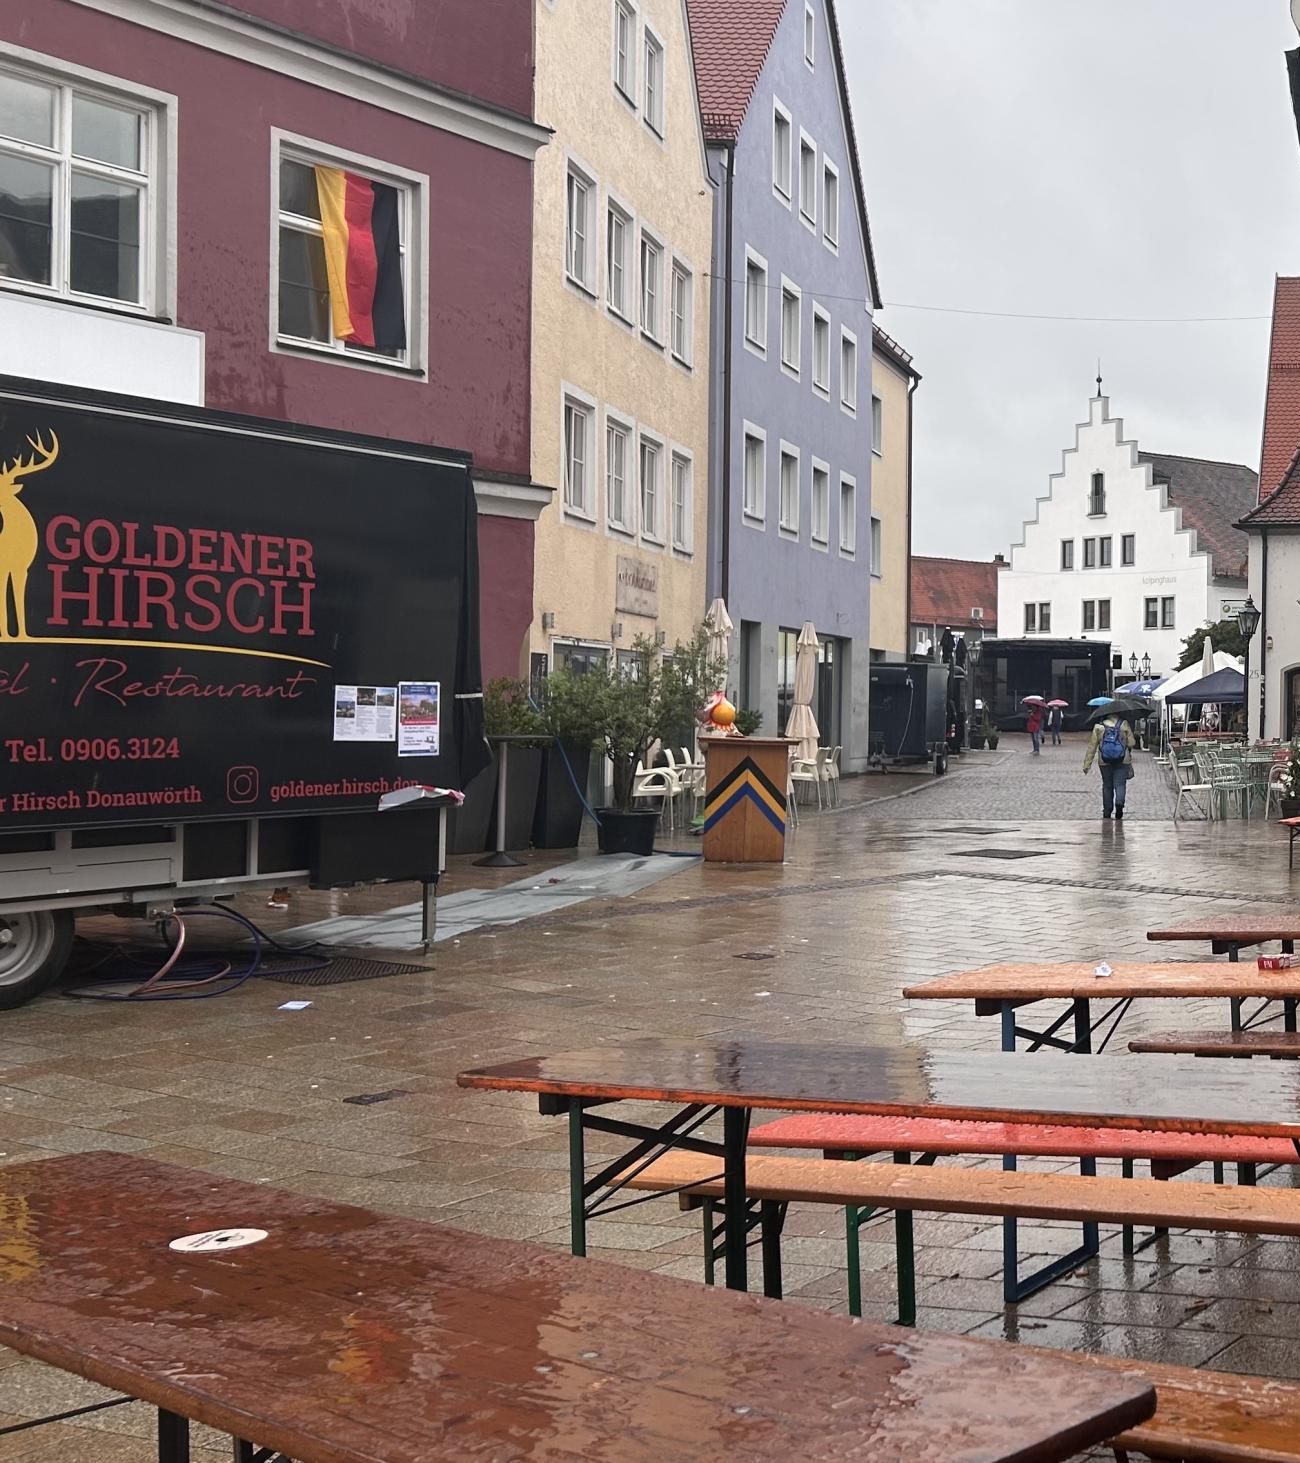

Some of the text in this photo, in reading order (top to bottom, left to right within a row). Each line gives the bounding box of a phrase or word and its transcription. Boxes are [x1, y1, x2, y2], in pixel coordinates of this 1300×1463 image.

[45, 515, 316, 579] GOLDENER
[46, 563, 316, 636] HIRSCH
[73, 657, 317, 707] Restaurant
[5, 737, 180, 762] Tel. 0906.3124
[12, 790, 81, 812] Hirsch
[86, 784, 203, 808] Donauwörth
